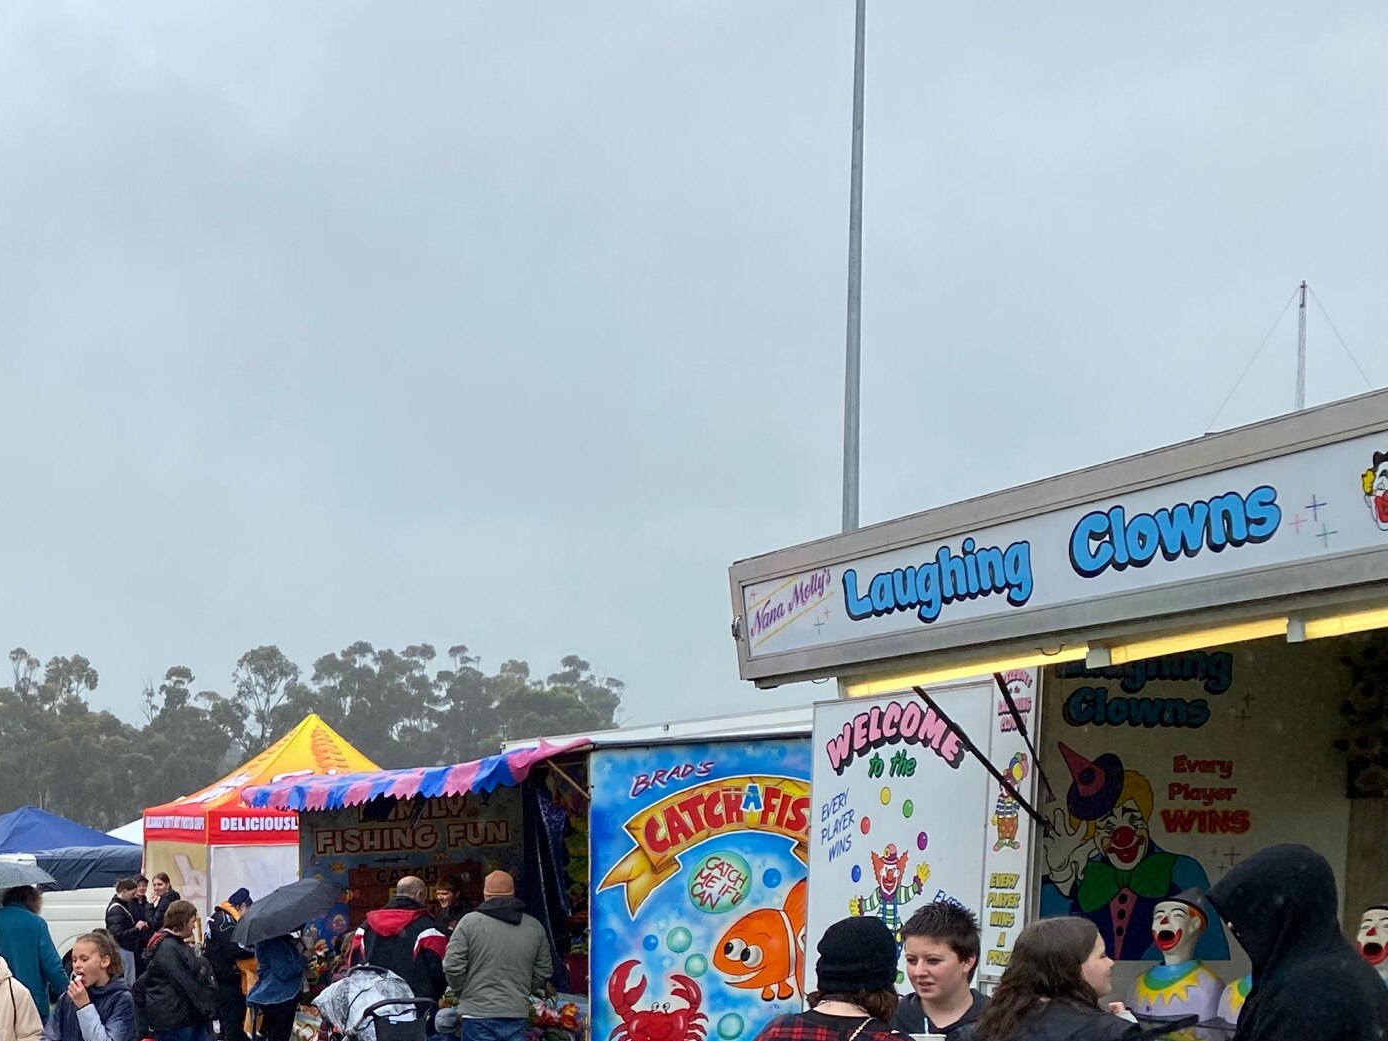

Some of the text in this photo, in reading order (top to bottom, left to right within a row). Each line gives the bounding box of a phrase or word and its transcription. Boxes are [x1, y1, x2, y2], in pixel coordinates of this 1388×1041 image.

[841, 484, 1282, 623] Laughing Clowns
[750, 568, 831, 637] Nana Molly's
[1062, 686, 1211, 729] Clowns
[825, 701, 967, 776] WELCOME
[868, 749, 917, 778] to the
[1173, 755, 1234, 779] Every
[630, 762, 714, 797] BRAD'S
[821, 788, 850, 822] EVERY
[1168, 783, 1238, 806] Player
[220, 816, 299, 831] DELICIOUSL
[643, 783, 811, 854] CATCH A FIS
[821, 809, 855, 845] PLAYER
[1161, 809, 1252, 834] WINS
[315, 820, 510, 854] FISHING FUN
[828, 836, 852, 862] WINS
[694, 867, 721, 889] ME
[718, 883, 737, 896] IF
[705, 856, 748, 889] CATCH
[989, 873, 1020, 889] EVERY
[690, 882, 721, 910] CAN
[986, 892, 1021, 909] PLAYER
[989, 911, 1015, 928] WINS
[997, 931, 1007, 947] A
[986, 949, 1012, 967] PRIZ
